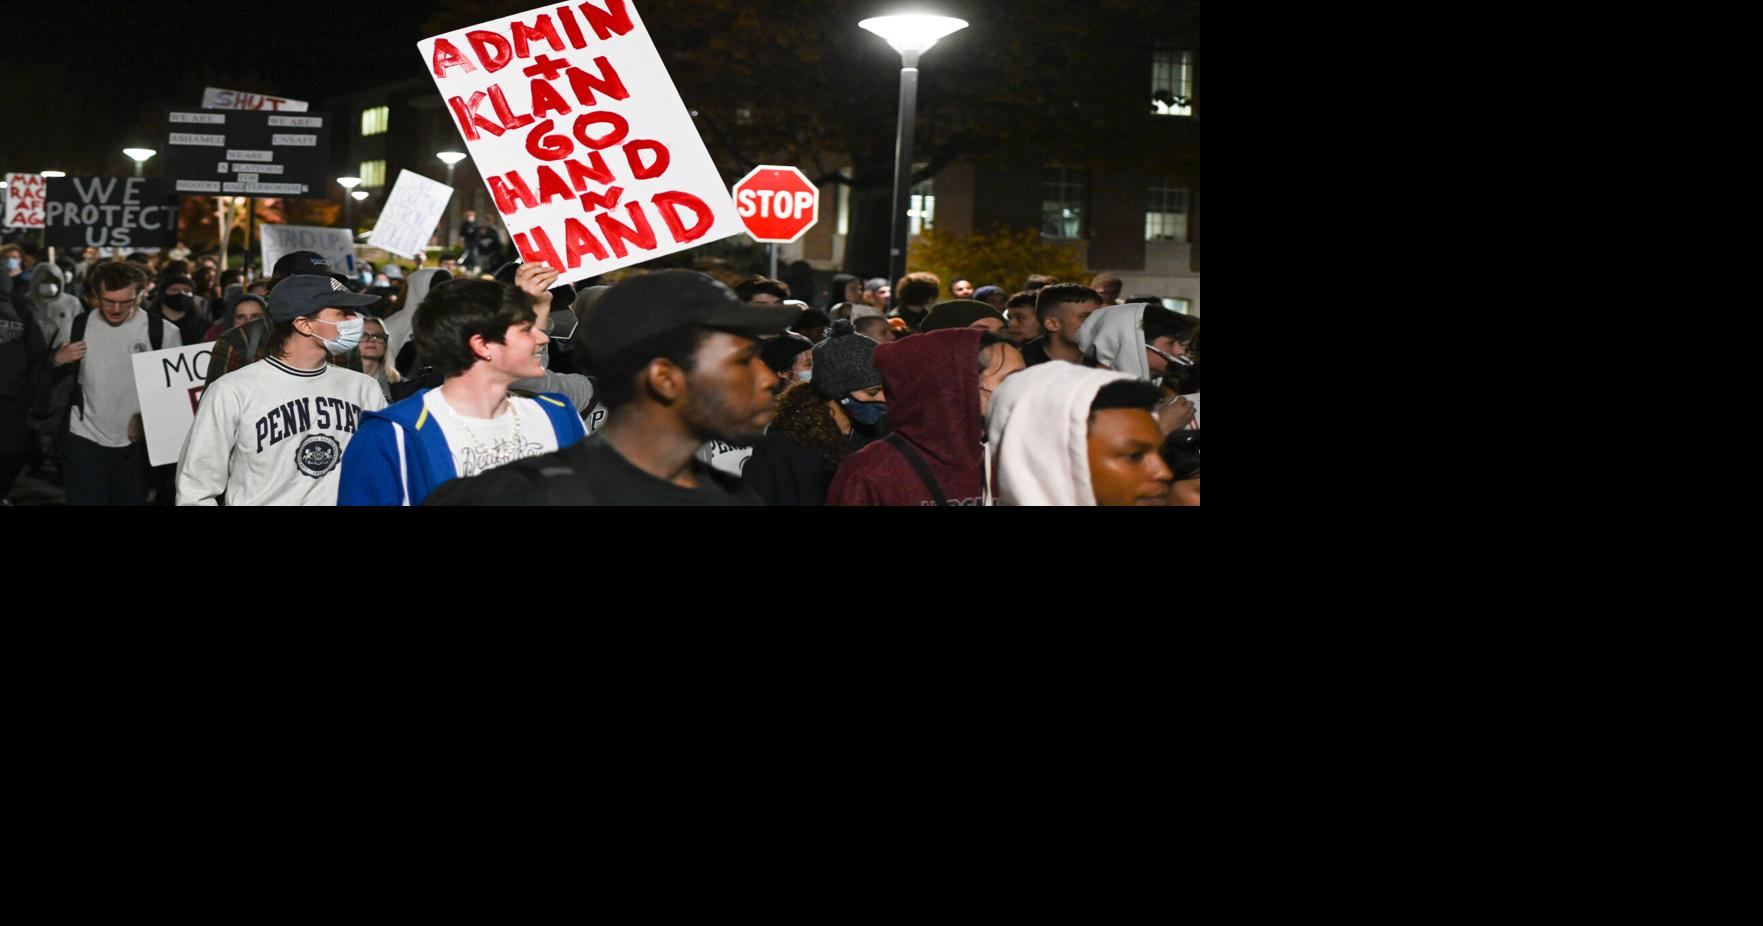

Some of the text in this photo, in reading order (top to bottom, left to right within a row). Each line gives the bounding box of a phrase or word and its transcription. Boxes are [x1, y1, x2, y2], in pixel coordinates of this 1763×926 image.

[433, 0, 634, 78] ADMIN
[214, 91, 287, 111] SHUT
[448, 56, 630, 141] KLAN
[525, 110, 629, 161] GO
[73, 177, 146, 205] WE
[487, 139, 671, 215] HAND
[46, 201, 179, 231] PROTECT
[738, 189, 814, 219] STOP
[85, 226, 131, 247] US
[513, 191, 715, 274] HAND
[256, 397, 311, 454] PENN
